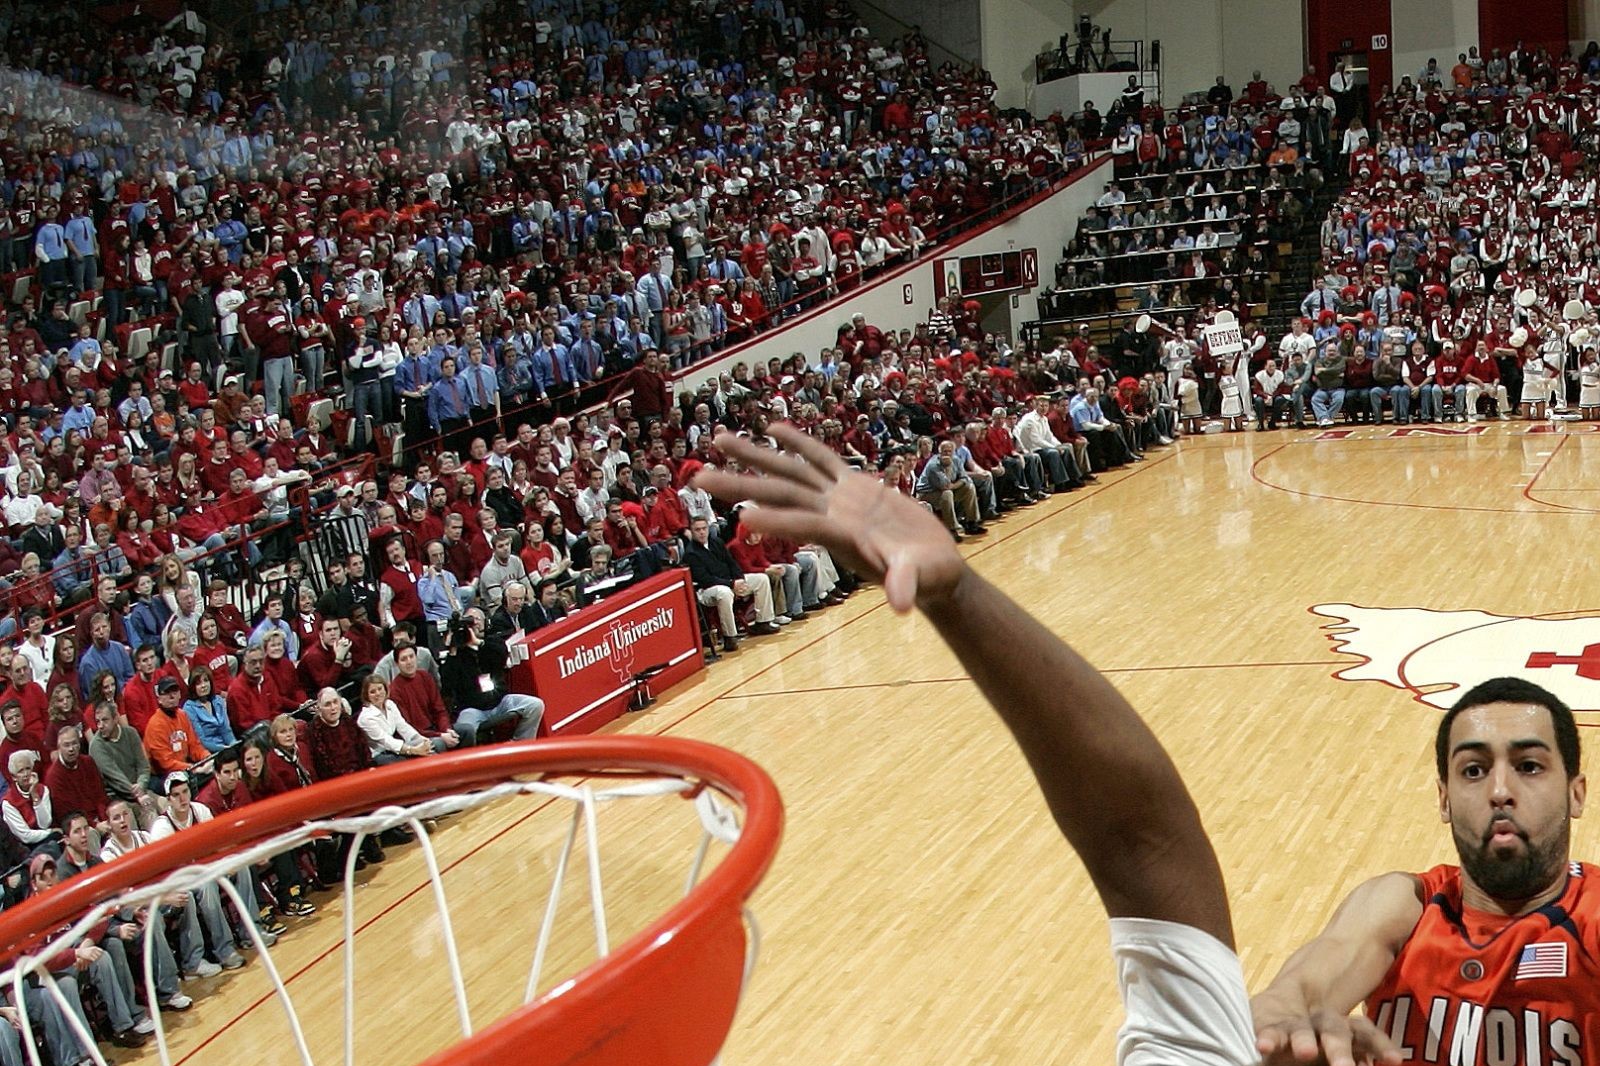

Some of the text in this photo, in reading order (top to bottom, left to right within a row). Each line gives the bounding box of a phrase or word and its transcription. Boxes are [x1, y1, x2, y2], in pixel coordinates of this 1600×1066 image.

[1376, 36, 1386, 47] 10
[905, 286, 912, 302] 9
[557, 606, 675, 680] Indiana University
